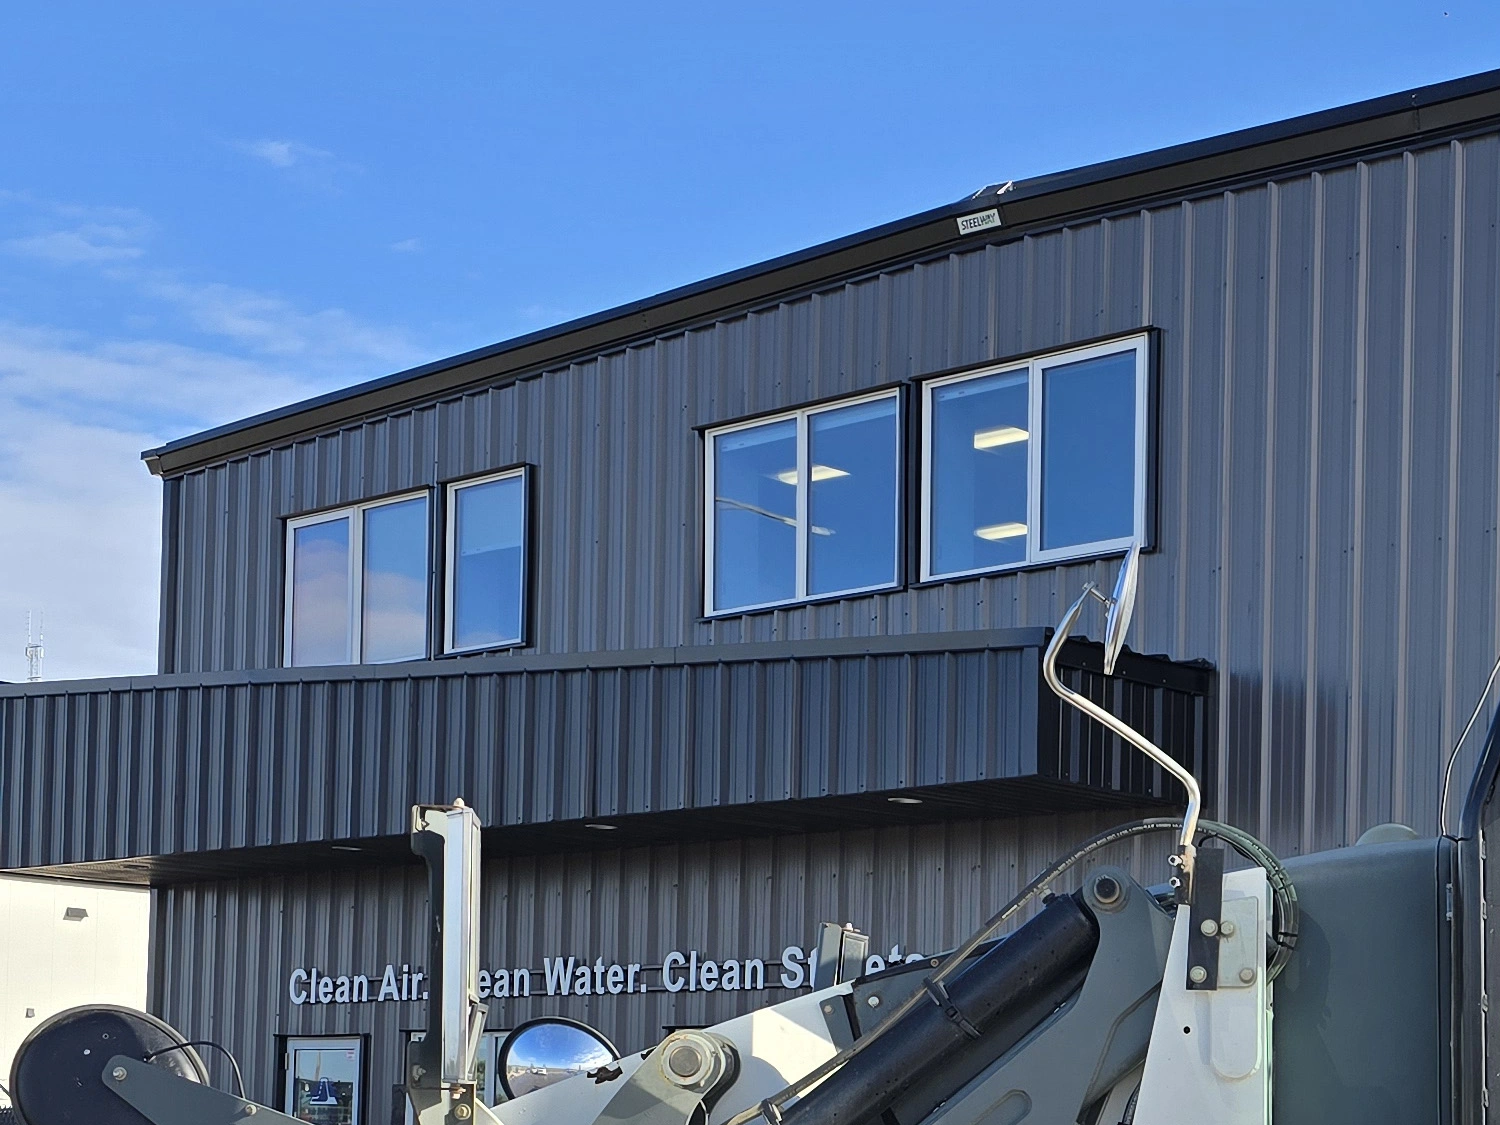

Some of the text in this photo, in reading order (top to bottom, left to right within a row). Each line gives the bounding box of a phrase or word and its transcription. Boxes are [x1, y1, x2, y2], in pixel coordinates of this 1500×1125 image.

[289, 967, 369, 1005] Clean
[377, 963, 429, 1002] Air.
[478, 967, 530, 999] ean
[543, 956, 647, 996] Water.
[662, 950, 765, 993] Clean
